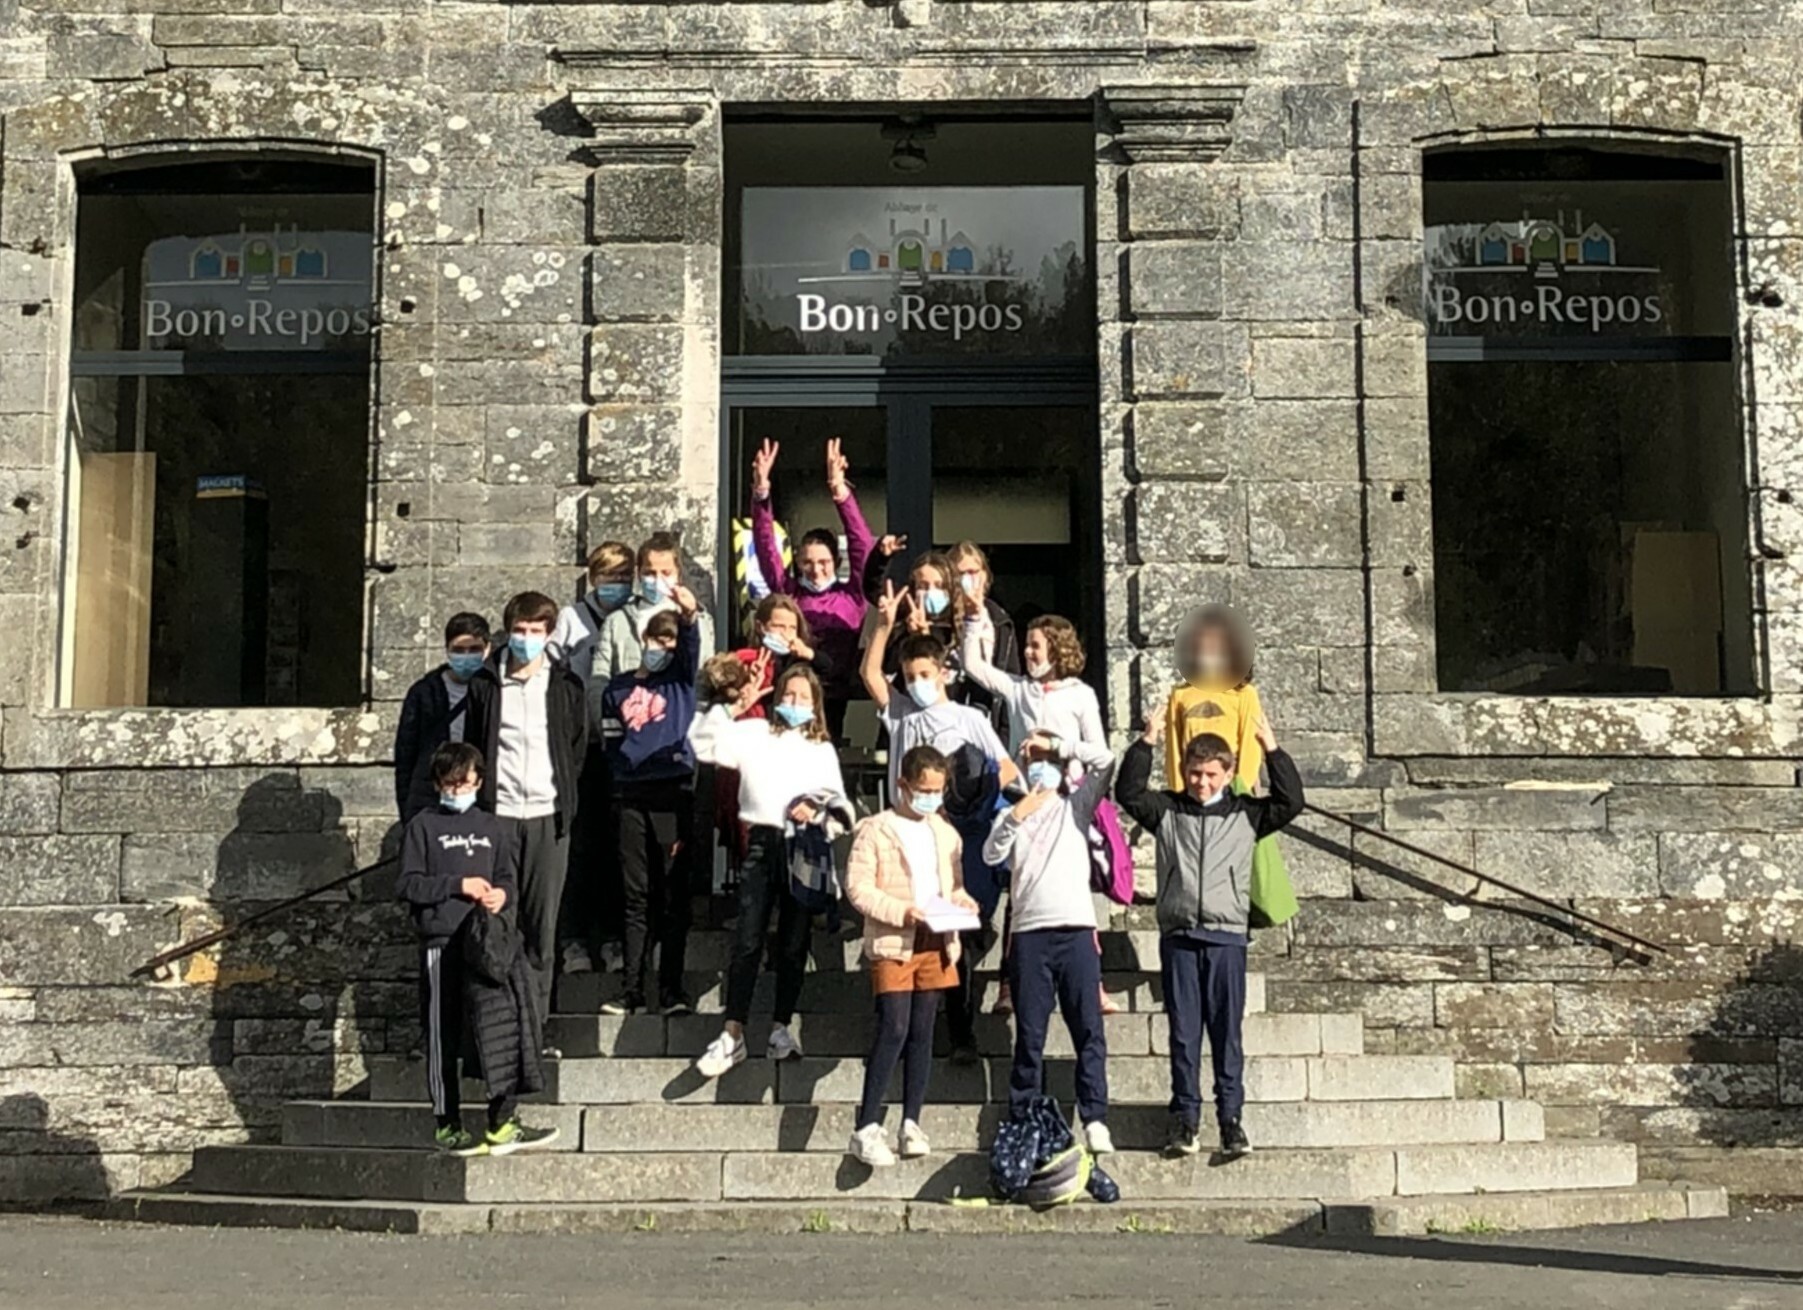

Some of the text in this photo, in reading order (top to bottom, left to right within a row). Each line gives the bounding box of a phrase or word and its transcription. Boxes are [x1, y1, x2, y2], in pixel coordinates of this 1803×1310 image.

[146, 299, 369, 346] Bon Repos
[797, 294, 1023, 340] Bon Repos
[1434, 285, 1662, 332] Bon Repos
